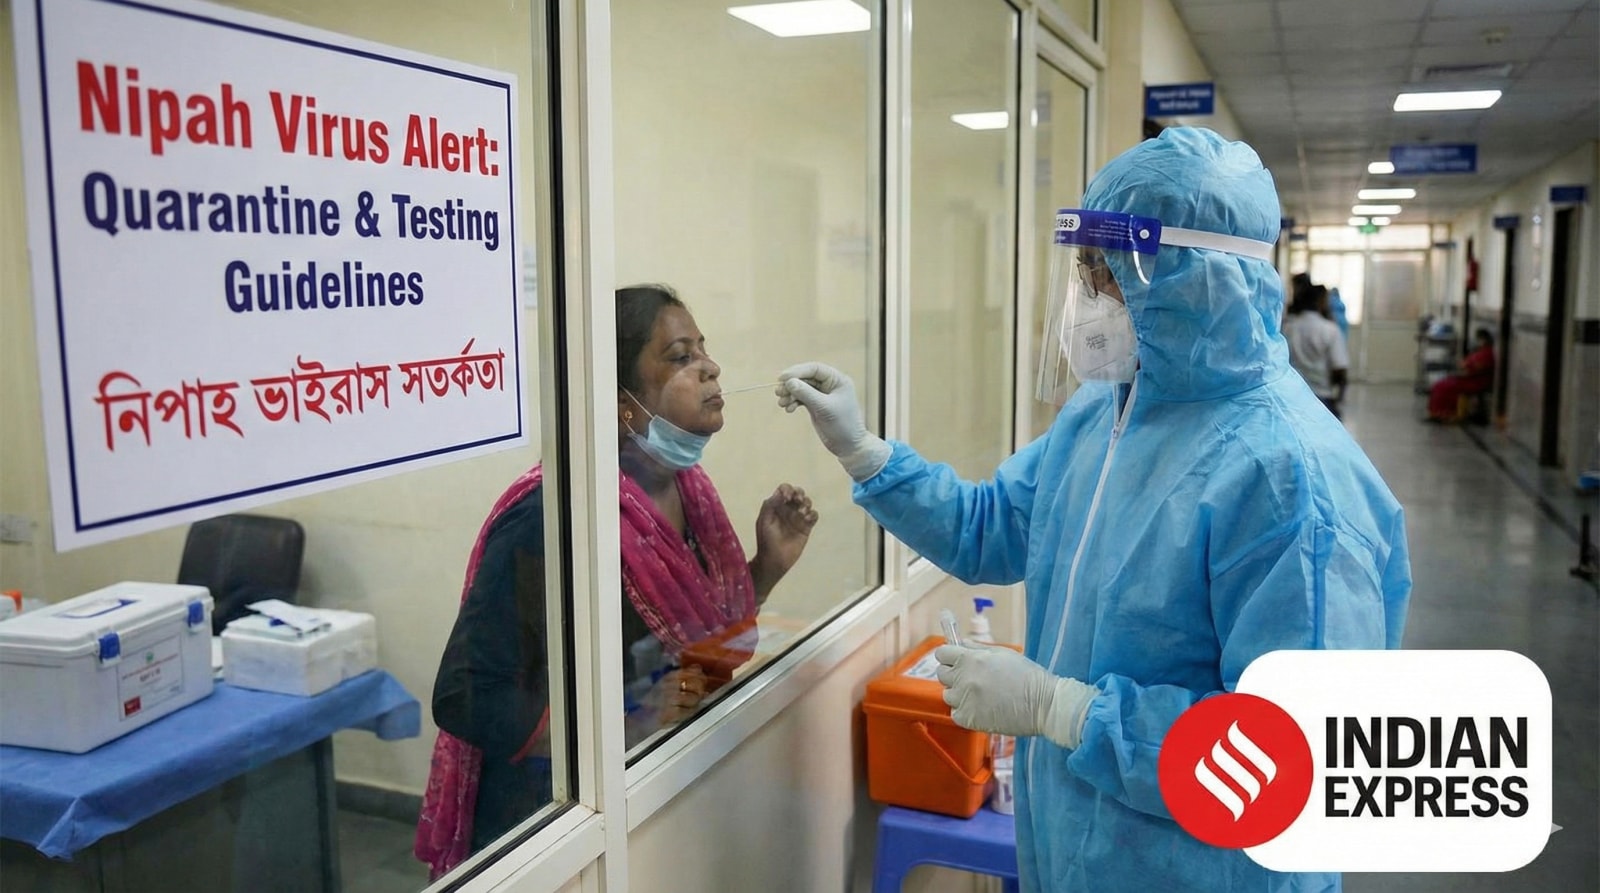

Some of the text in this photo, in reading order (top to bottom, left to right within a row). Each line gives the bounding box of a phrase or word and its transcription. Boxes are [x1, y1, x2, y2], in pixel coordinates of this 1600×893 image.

[77, 60, 499, 176] Nipah Virus Alert:
[83, 171, 499, 251] Quarantine & Testing
[224, 260, 424, 313] Guidelines
[94, 338, 505, 451] নিপাহ ভাইরাস সতর্কতা
